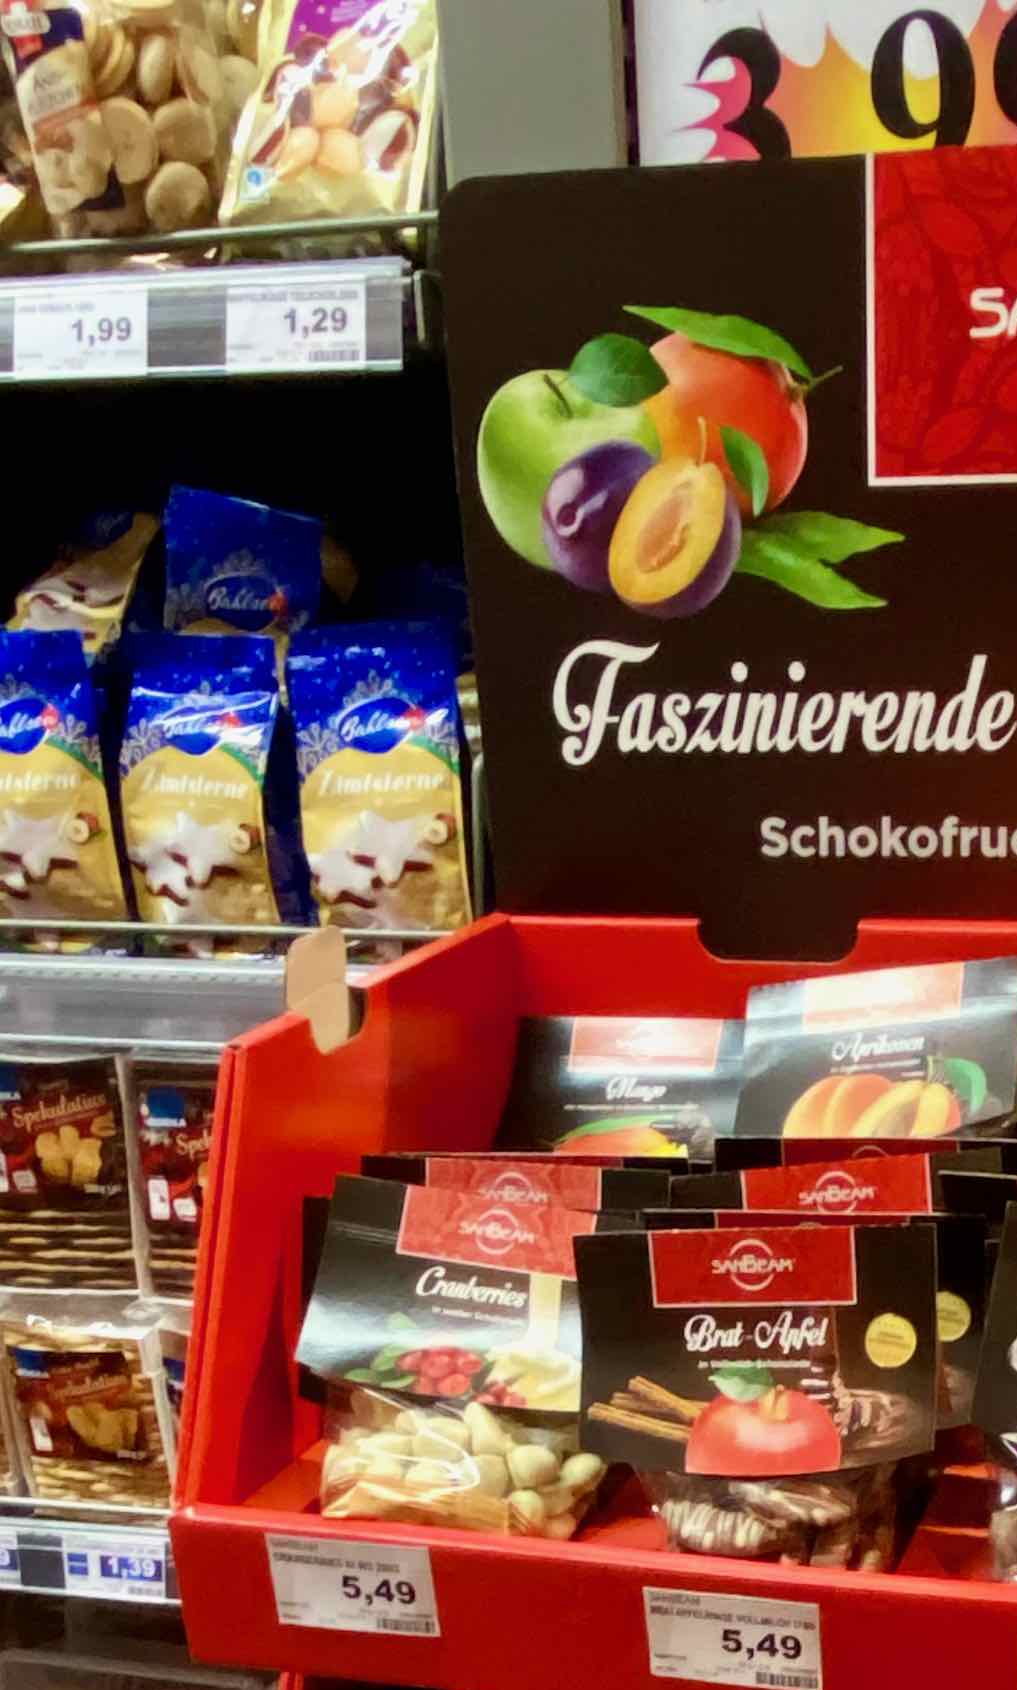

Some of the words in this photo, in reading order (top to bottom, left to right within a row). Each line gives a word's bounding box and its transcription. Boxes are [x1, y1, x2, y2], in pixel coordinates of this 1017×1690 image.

[72, 317, 132, 347] 1,99
[283, 306, 348, 339] 1,29
[553, 640, 1017, 766] Faszinierende
[415, 1266, 530, 1308] Cranberries
[342, 1575, 416, 1606] 5,49
[722, 1629, 803, 1661] 5,49
